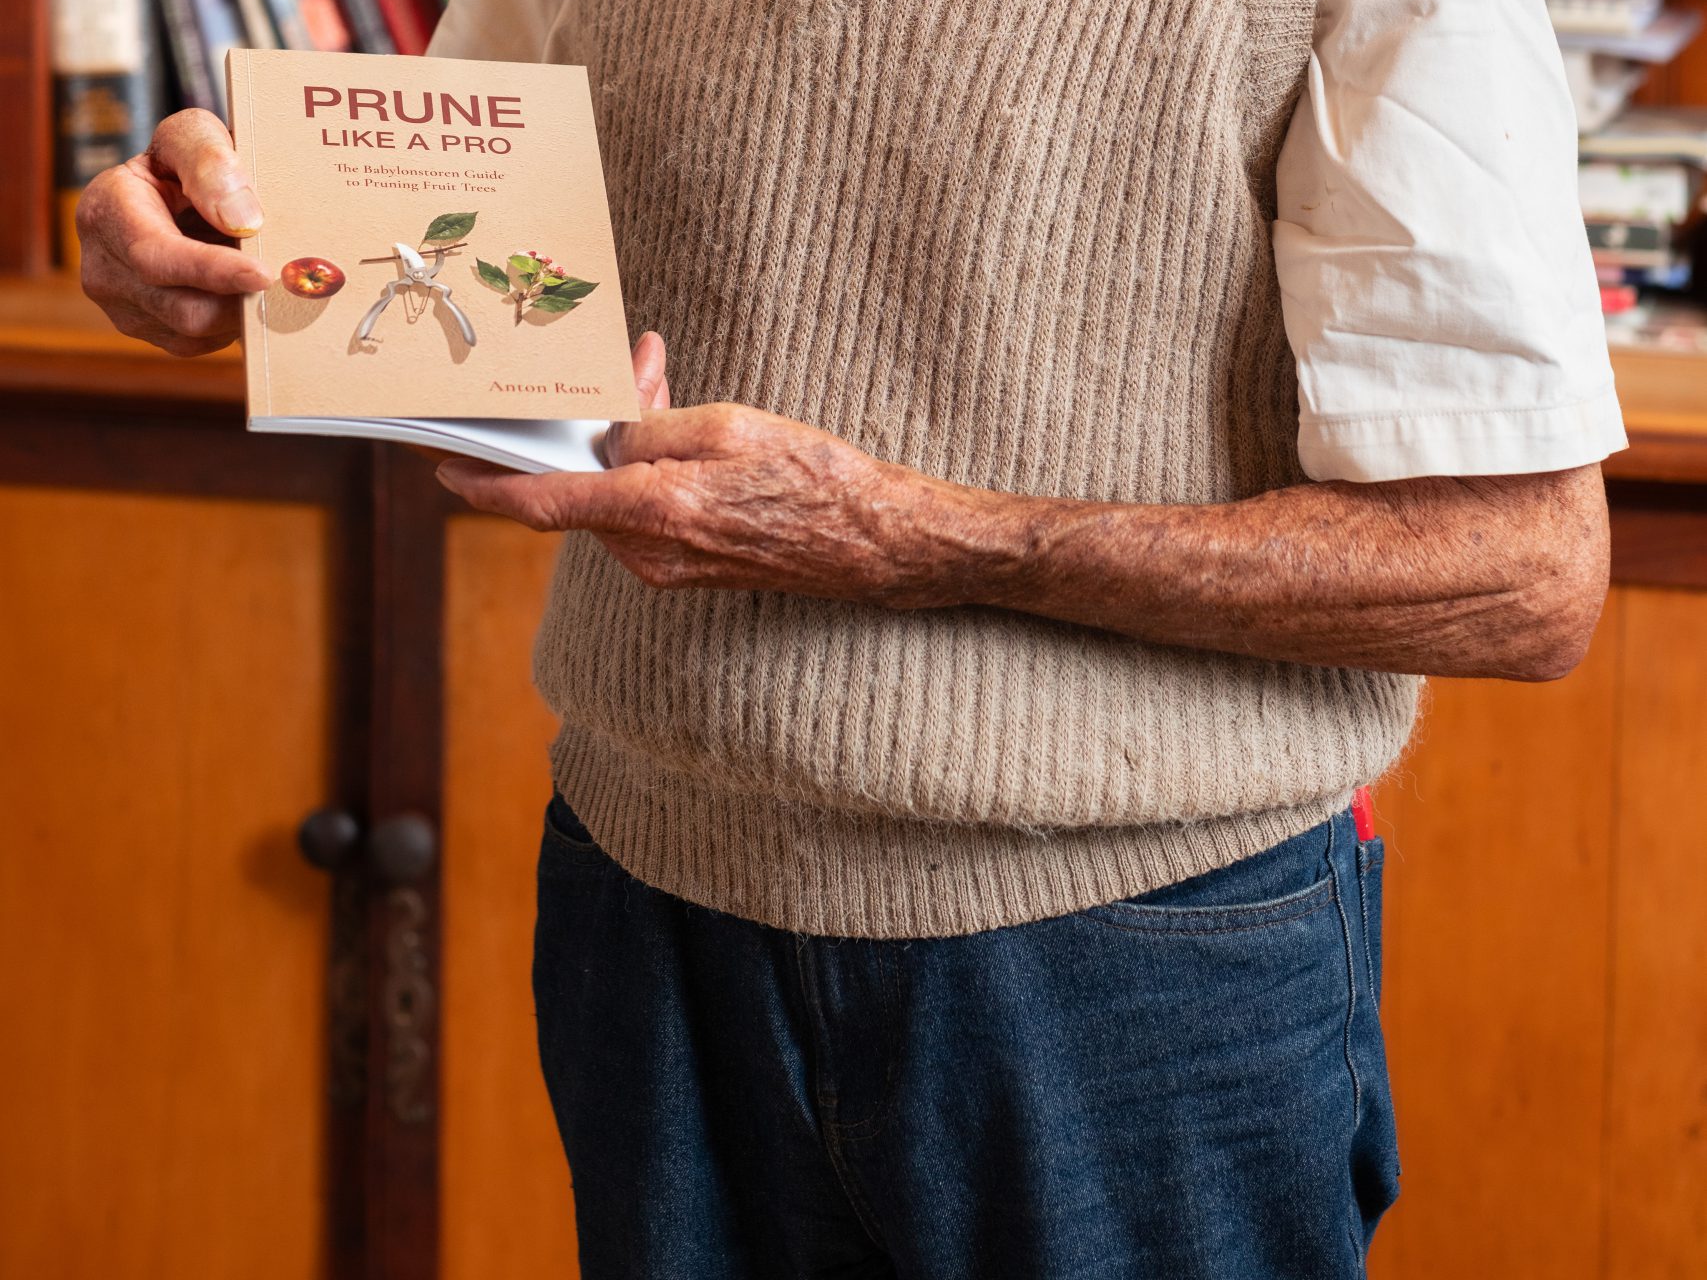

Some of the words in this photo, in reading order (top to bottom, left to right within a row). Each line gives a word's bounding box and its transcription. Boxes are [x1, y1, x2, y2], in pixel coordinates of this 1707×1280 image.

[303, 85, 525, 129] PRUNE
[321, 128, 396, 149] LIKE
[406, 133, 431, 151] A
[441, 134, 512, 155] PRO
[333, 163, 359, 173] The
[363, 164, 460, 179] Babylonstoren
[463, 169, 505, 180] Guide
[345, 179, 360, 187] to
[364, 178, 419, 193] Pruning
[423, 181, 457, 191] Fruit
[460, 183, 497, 193] Trees
[489, 380, 547, 394] Anton
[554, 381, 601, 395] Roux
